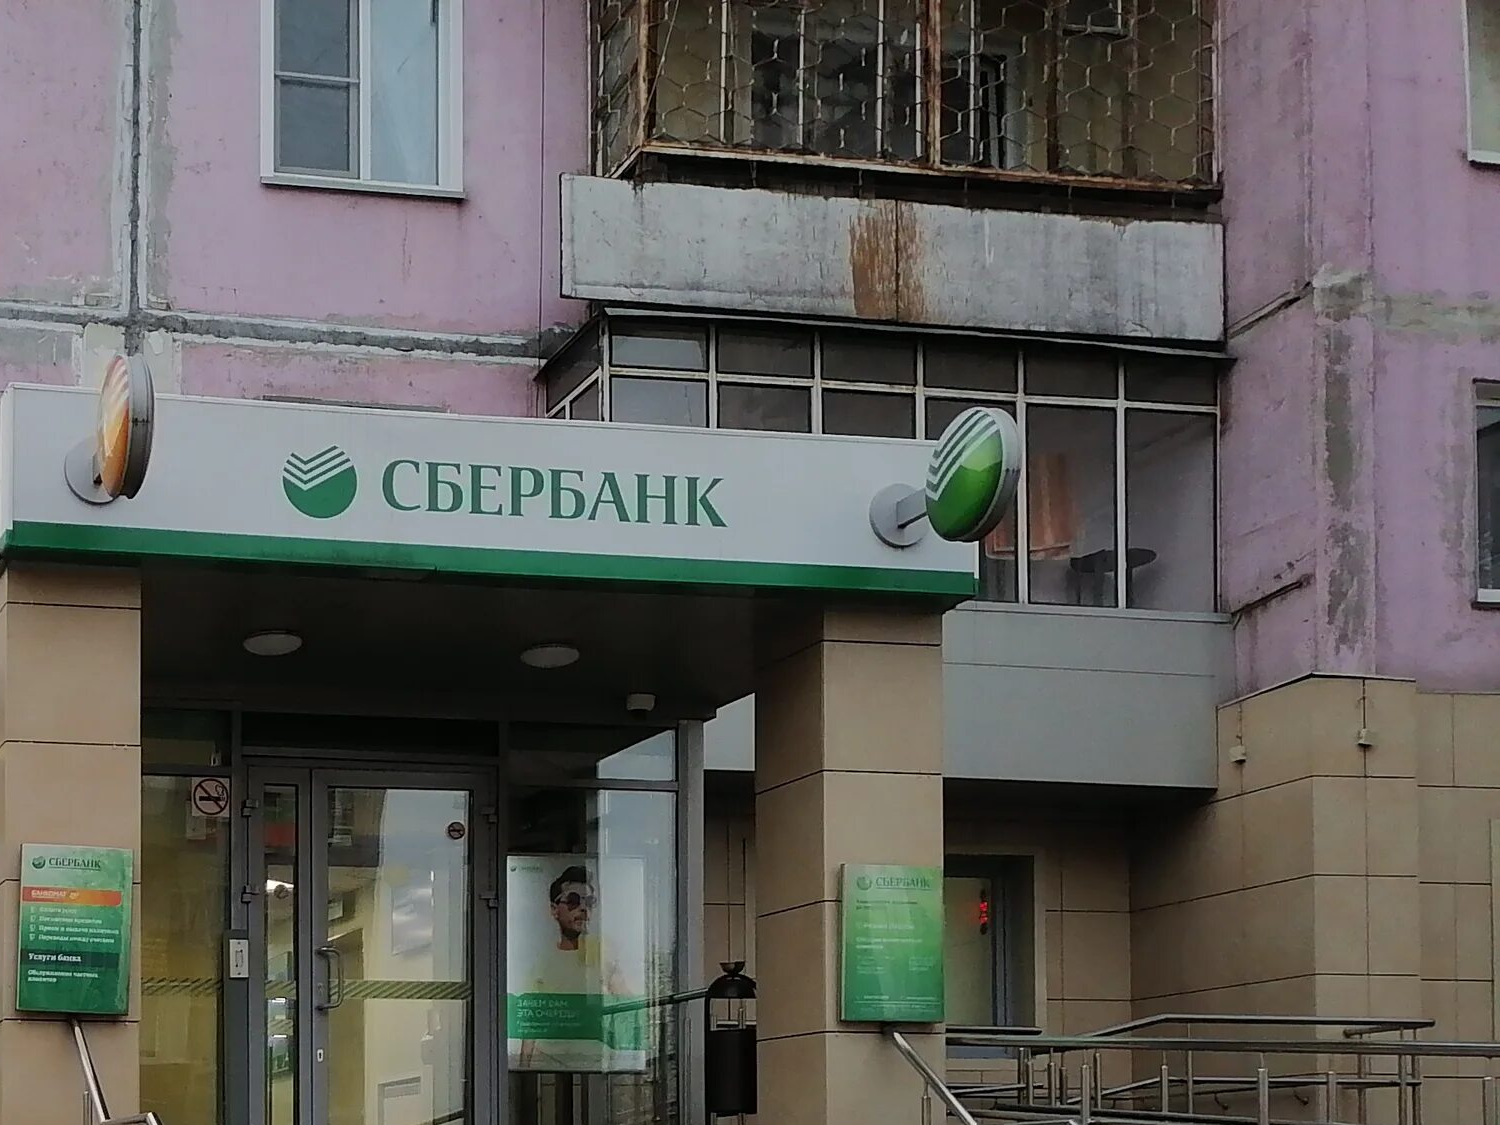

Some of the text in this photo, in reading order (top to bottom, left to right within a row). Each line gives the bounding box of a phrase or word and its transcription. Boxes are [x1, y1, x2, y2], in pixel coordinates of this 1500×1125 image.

[381, 458, 729, 528] СБЕРБАНК
[48, 857, 101, 869] СБЕРБАНК
[875, 876, 931, 889] СБЕРБАНК
[28, 952, 82, 962] Услуги банка
[516, 1008, 534, 1017] ЭТА
